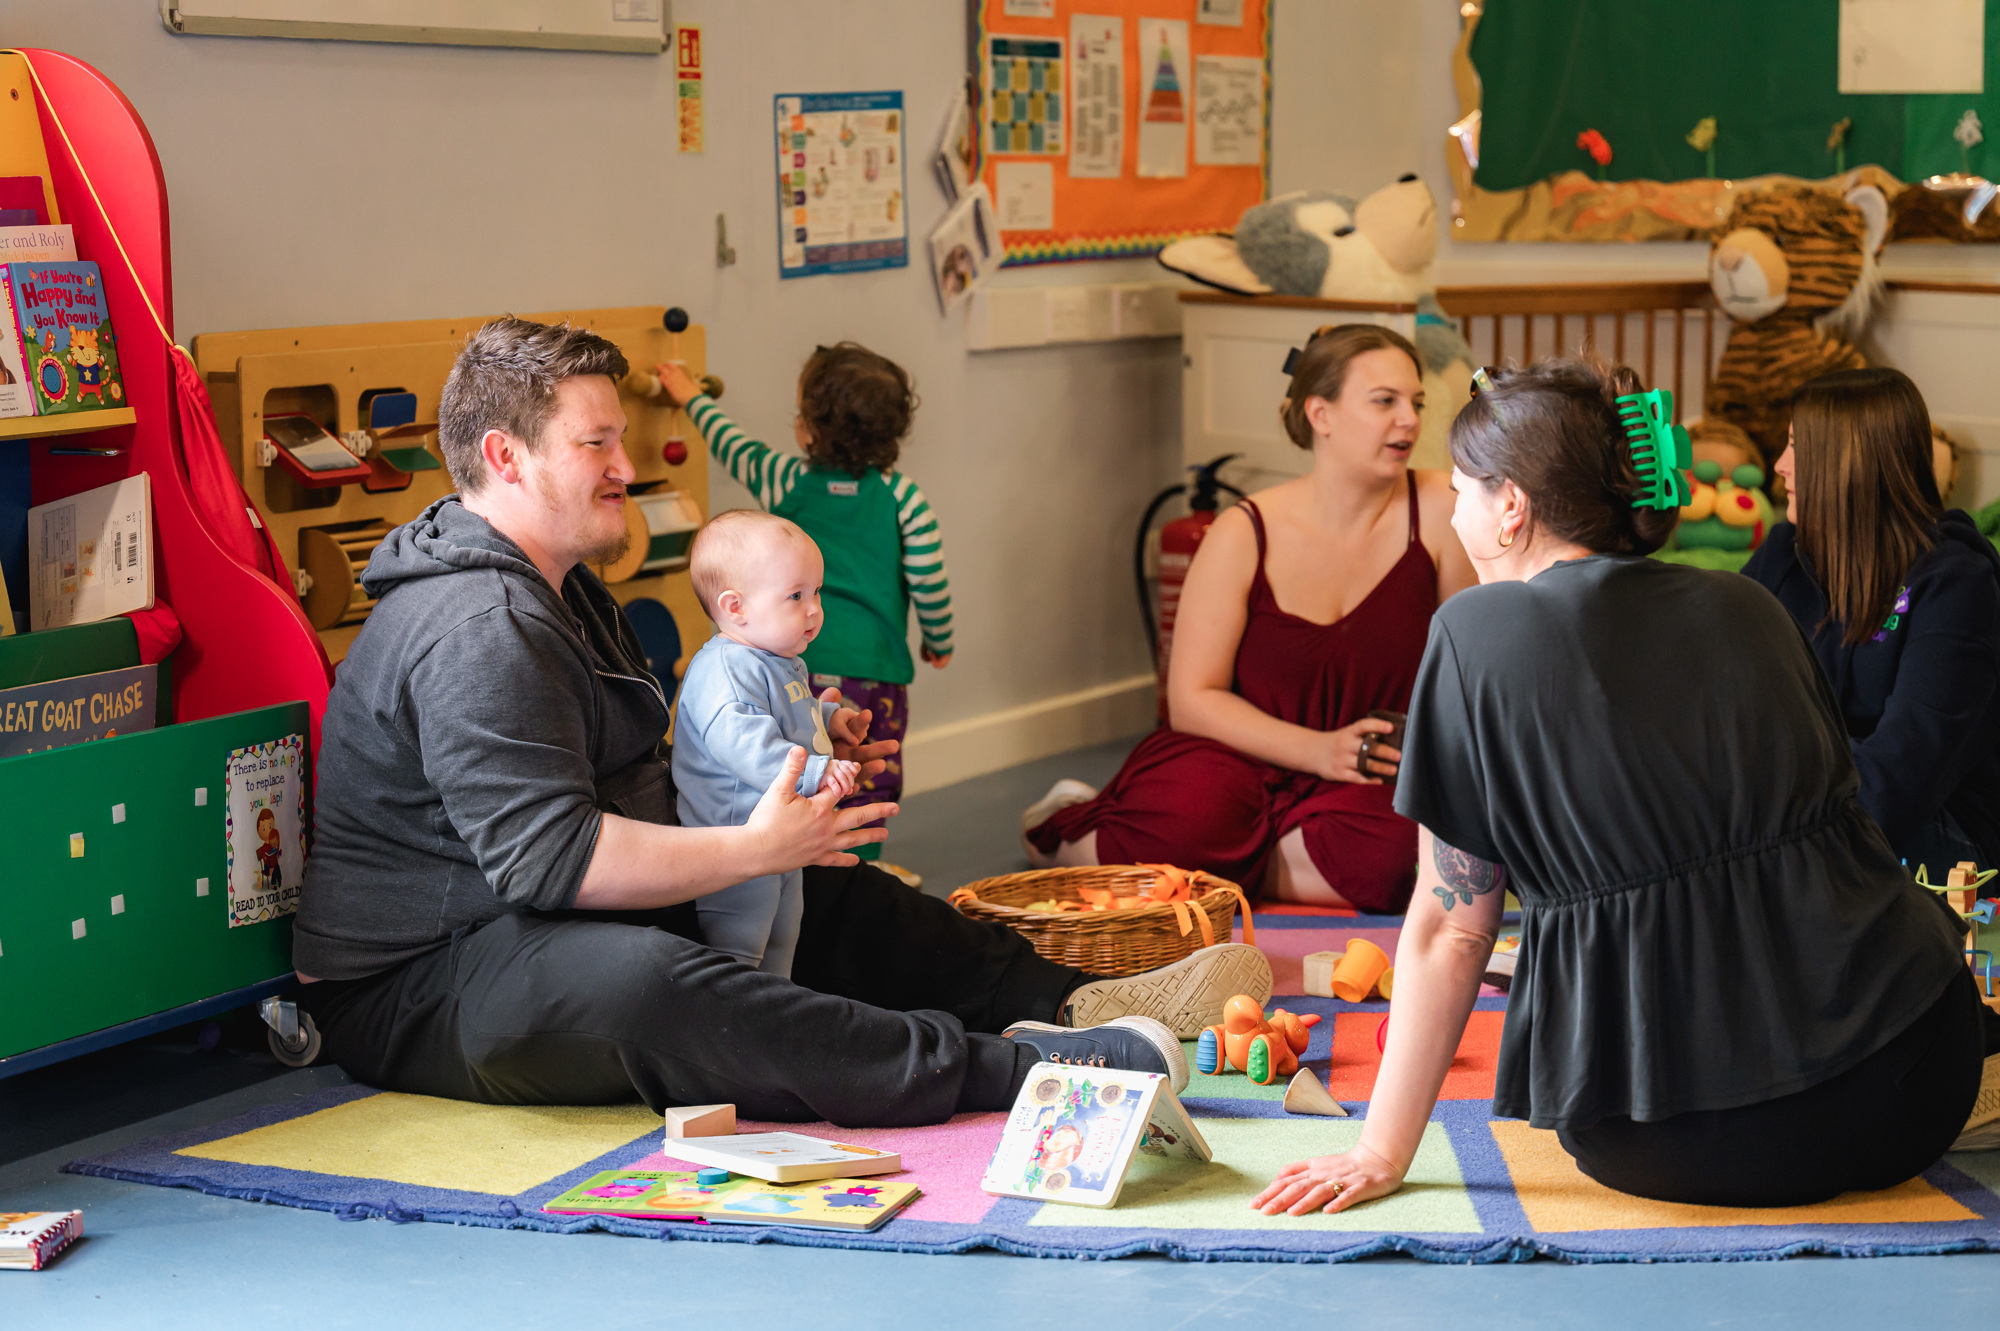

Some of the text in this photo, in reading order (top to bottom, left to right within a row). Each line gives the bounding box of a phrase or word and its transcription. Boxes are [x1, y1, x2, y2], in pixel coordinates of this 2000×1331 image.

[13, 232, 37, 248] and
[39, 231, 65, 250] Roly
[22, 250, 50, 262] Inkpen
[39, 269, 83, 285] If You're
[21, 282, 97, 309] Happy and
[33, 308, 100, 329] You Know It
[0, 680, 143, 733] EAT GOAT CHASE
[233, 763, 257, 776] There
[259, 759, 267, 770] is
[269, 759, 278, 768] no
[246, 775, 285, 791] to replace
[250, 798, 268, 812] your
[236, 898, 255, 912] READ
[257, 896, 265, 908] TO
[266, 891, 280, 905] YOUR
